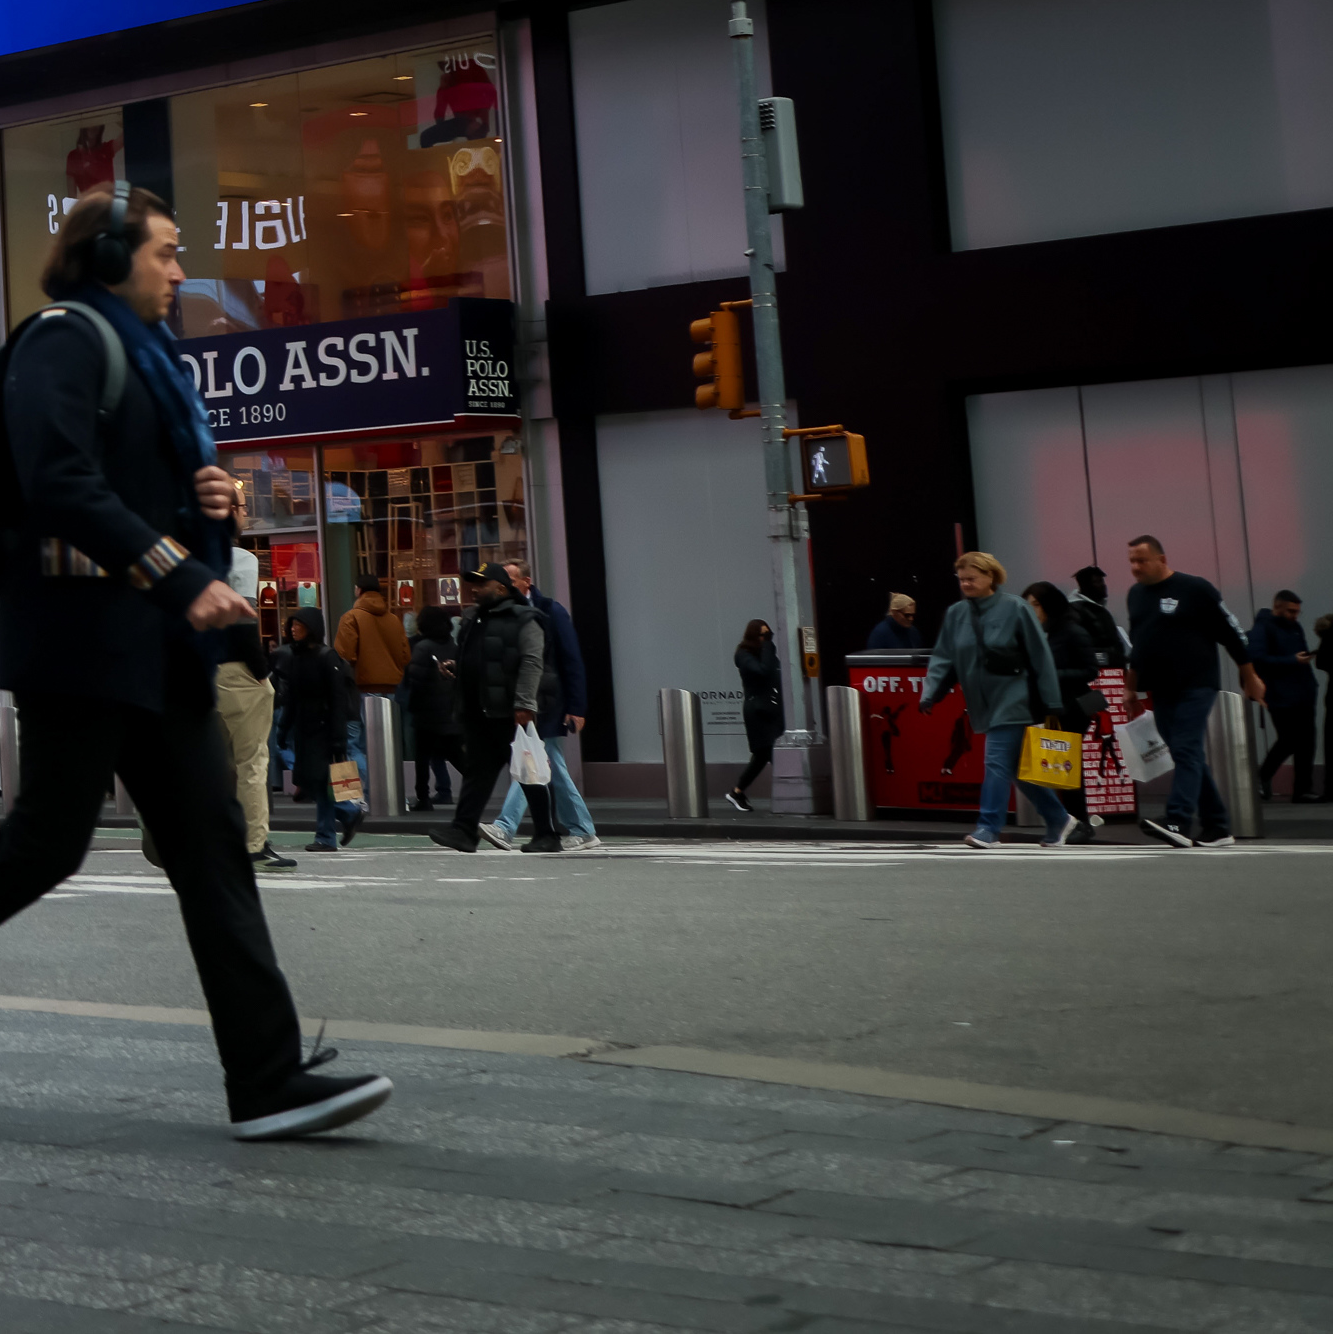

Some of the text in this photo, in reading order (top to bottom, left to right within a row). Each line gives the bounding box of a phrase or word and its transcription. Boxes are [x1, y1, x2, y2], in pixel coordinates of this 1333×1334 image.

[464, 339, 494, 357] U.S.
[279, 327, 431, 393] ASSN.
[466, 359, 508, 378] POLO
[467, 379, 513, 397] ASSN.
[238, 402, 288, 426] 1890
[863, 676, 904, 693] OFF.
